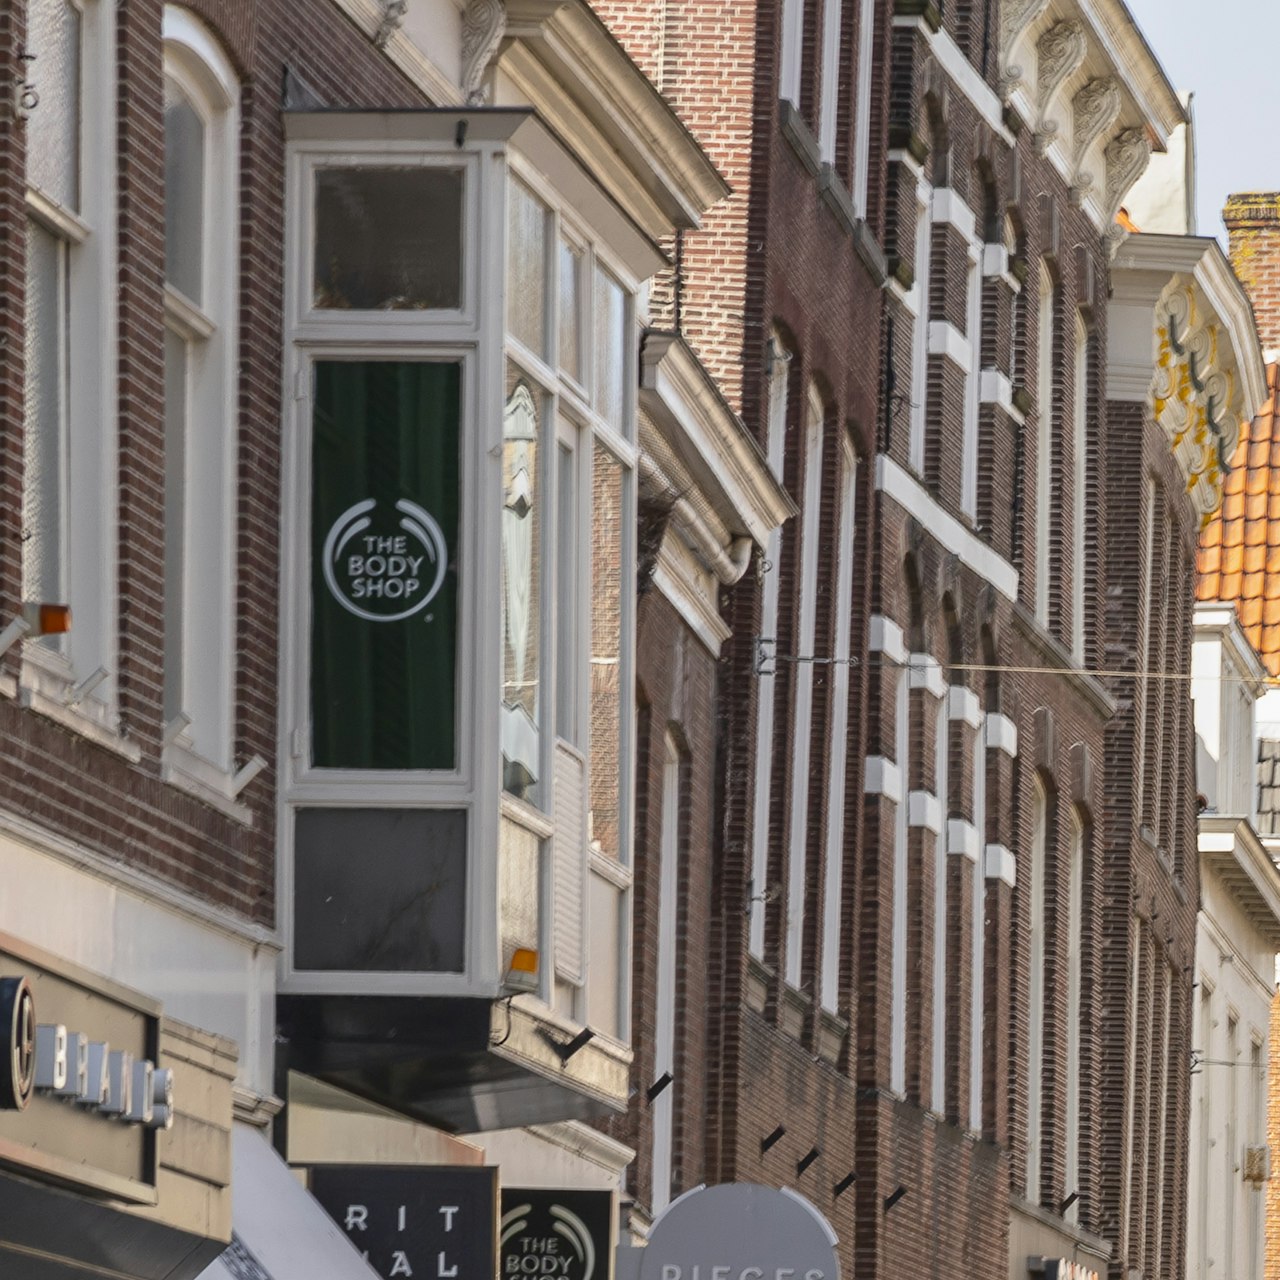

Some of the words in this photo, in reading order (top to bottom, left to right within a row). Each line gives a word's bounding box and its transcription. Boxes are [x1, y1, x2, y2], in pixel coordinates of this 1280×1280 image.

[362, 535, 407, 554] THE
[348, 555, 424, 577] BODY
[351, 577, 420, 598] SHOP
[519, 1237, 560, 1254] THE
[362, 1250, 459, 1278] AL
[505, 1255, 575, 1275] BODY
